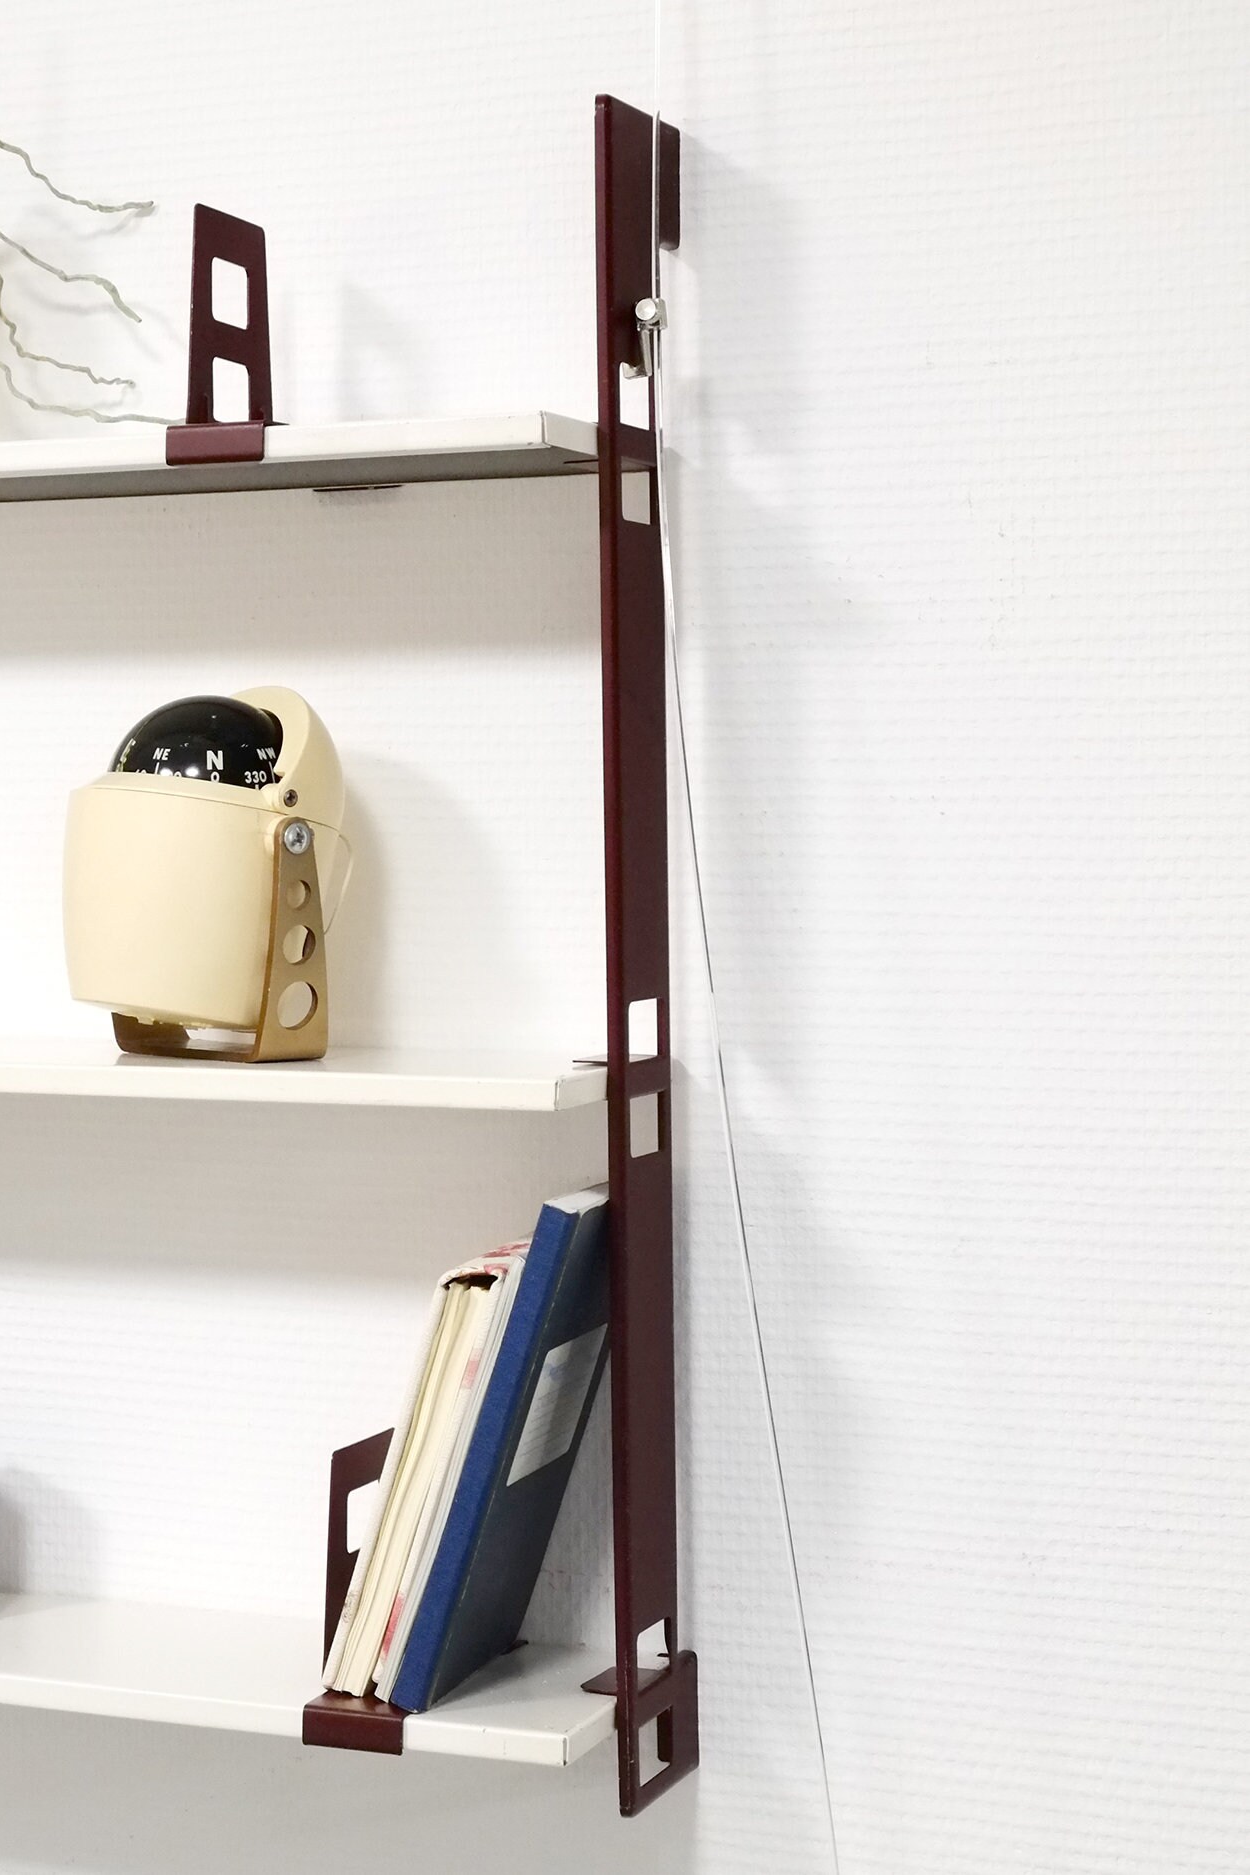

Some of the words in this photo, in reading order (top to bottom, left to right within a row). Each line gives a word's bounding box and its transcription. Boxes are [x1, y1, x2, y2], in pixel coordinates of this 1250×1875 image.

[153, 747, 171, 761] NE
[206, 750, 224, 770] N
[256, 747, 277, 760] NW
[244, 770, 267, 784] 330
